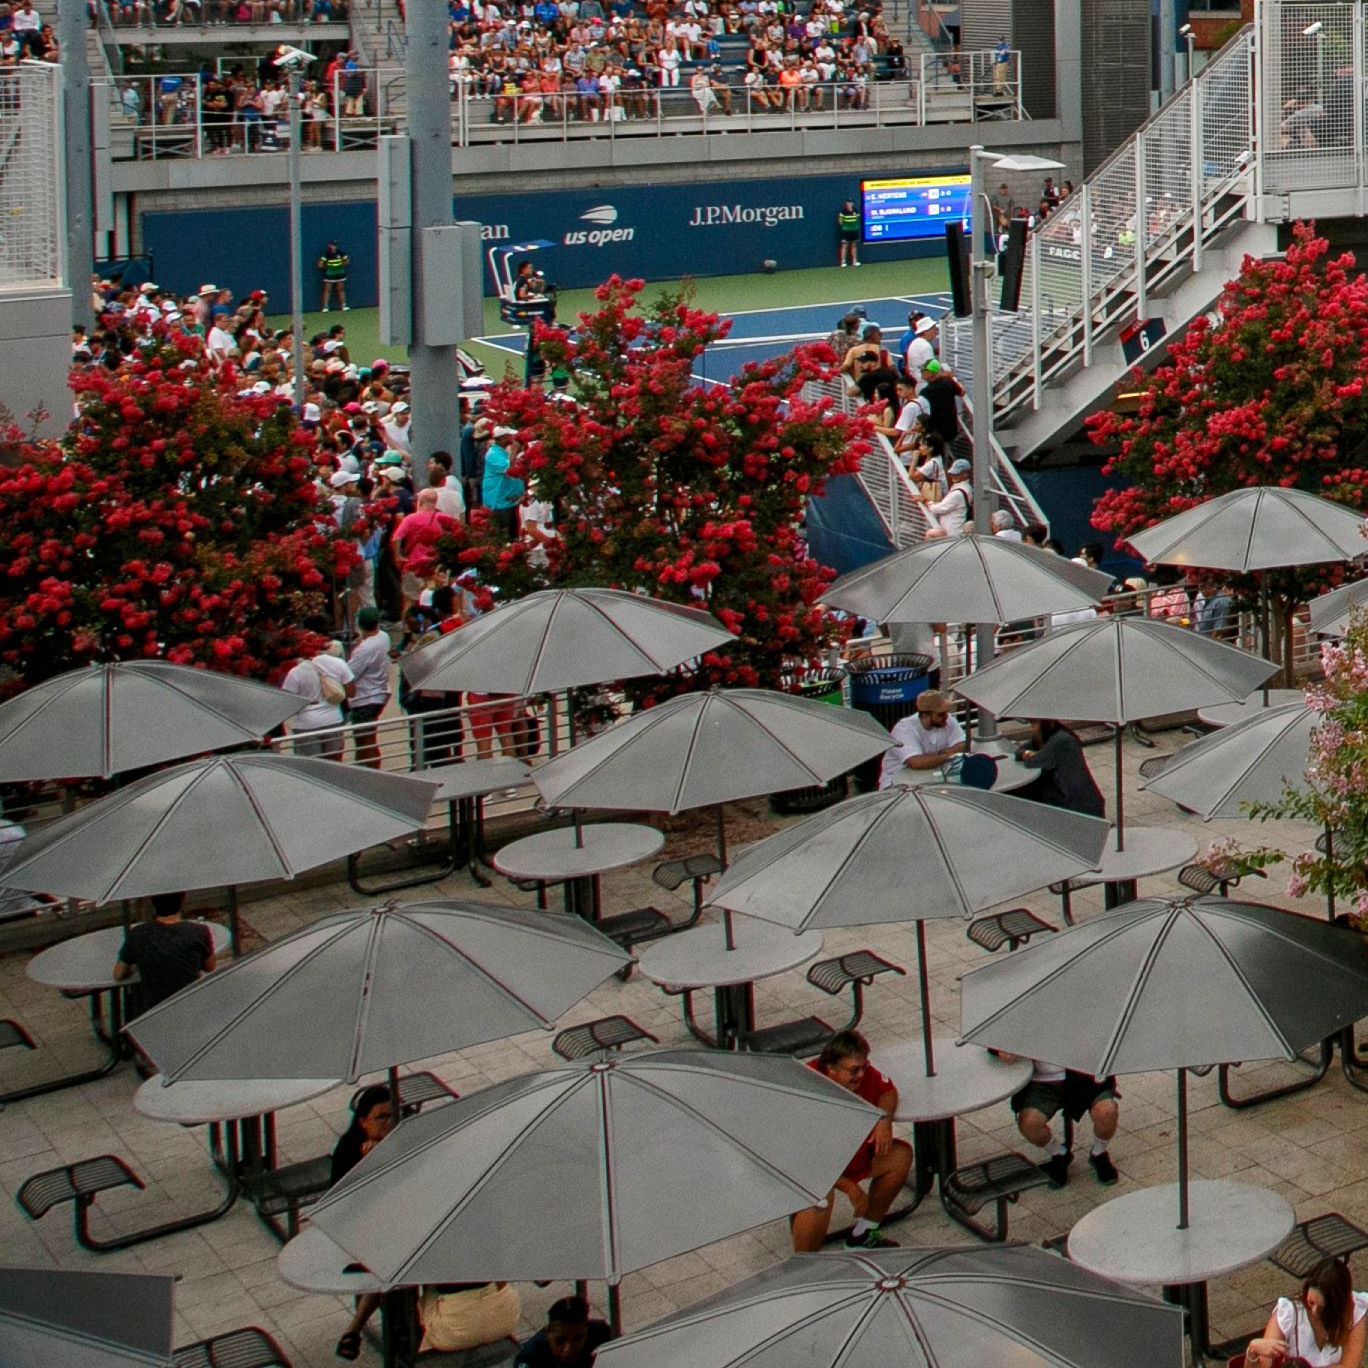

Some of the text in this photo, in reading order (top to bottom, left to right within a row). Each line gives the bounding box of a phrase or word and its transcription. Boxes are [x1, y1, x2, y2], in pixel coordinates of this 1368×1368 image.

[689, 204, 805, 228] J.P.Morgan
[564, 227, 635, 247] us open
[1140, 330, 1150, 351] 6
